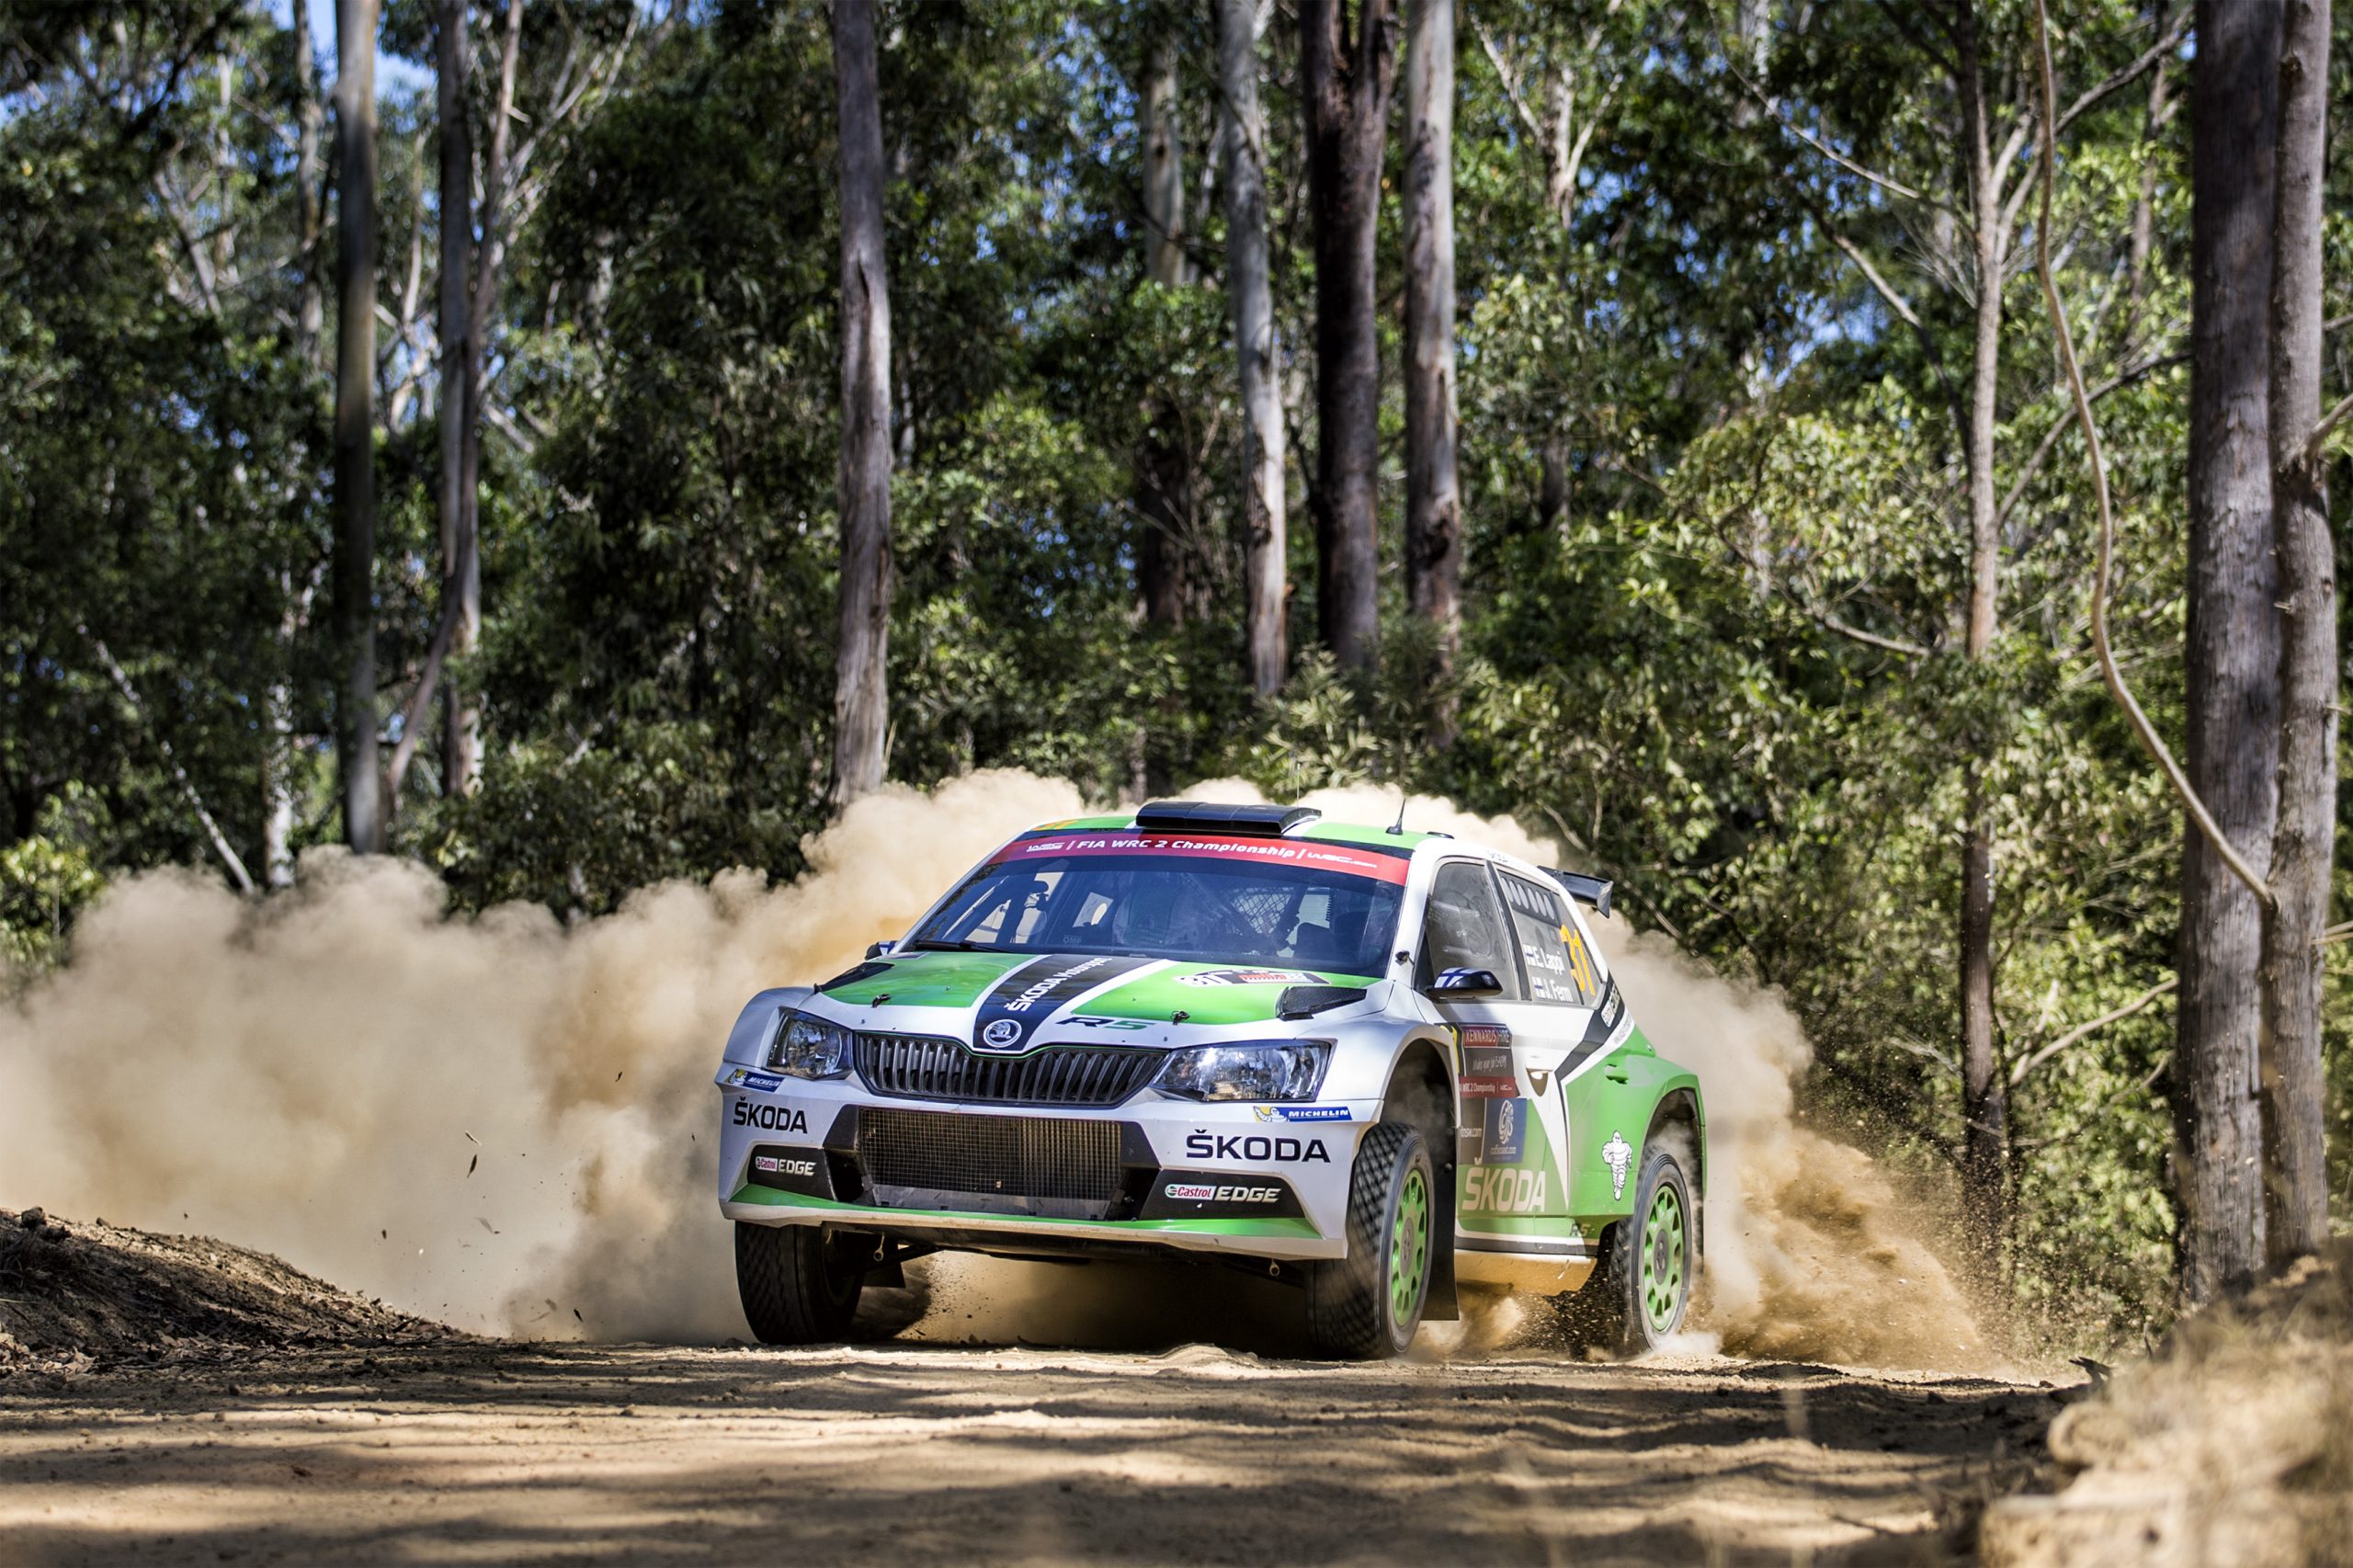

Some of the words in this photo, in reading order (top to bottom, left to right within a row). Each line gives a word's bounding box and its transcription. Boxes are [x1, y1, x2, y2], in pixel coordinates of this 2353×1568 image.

[1077, 840, 1107, 848] FIA
[1111, 840, 1153, 848] WRC
[1171, 840, 1296, 858] Championship
[1560, 923, 1596, 996] 31
[1004, 976, 1068, 1012] ŠKODA
[1055, 1016, 1157, 1030] R5
[1465, 1028, 1497, 1043] KENNARDS
[747, 1076, 782, 1087] MICHELIN
[733, 1096, 808, 1134] ŠKODA
[1289, 1109, 1349, 1118] MICHELIN
[1186, 1129, 1332, 1164] ŠKODA
[760, 1158, 778, 1170] Castrol
[778, 1158, 817, 1176] EDGE
[1461, 1157, 1546, 1212] ŠKODA
[1177, 1186, 1212, 1198] Castrol
[1214, 1186, 1281, 1203] EDGE
